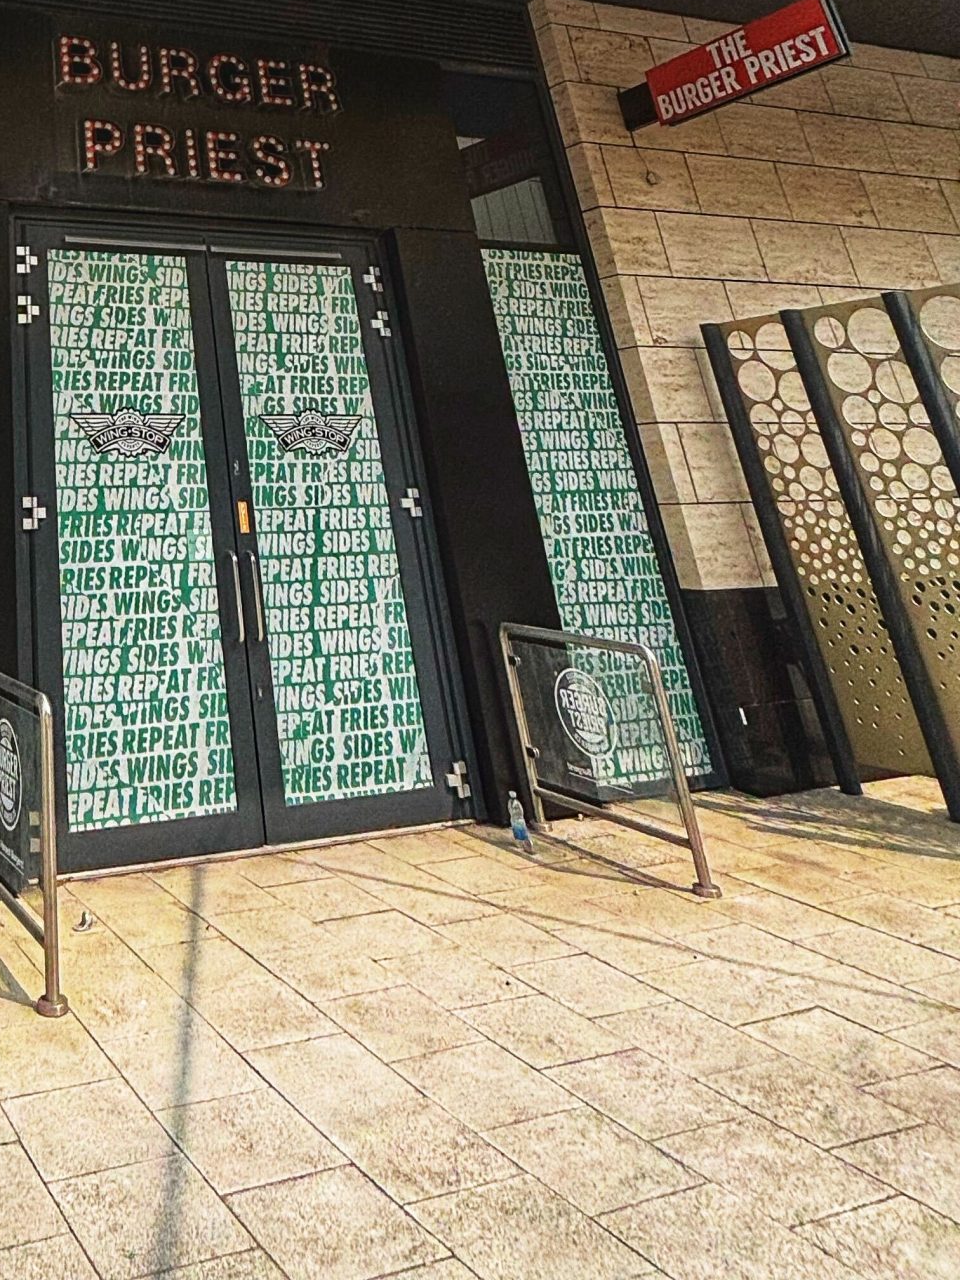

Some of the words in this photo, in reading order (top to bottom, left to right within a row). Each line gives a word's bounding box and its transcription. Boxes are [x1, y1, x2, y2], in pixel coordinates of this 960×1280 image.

[706, 29, 752, 69] THE
[58, 34, 342, 113] BURGER
[657, 66, 741, 121] BURGER
[744, 26, 830, 84] PRIEST
[84, 119, 332, 189] PRIEST
[89, 263, 149, 283] WINGS
[273, 274, 317, 293] SIDES
[266, 292, 329, 314] REPEAT
[99, 305, 147, 327] SIDES
[270, 312, 329, 334] WINGS
[514, 317, 562, 336] WINGS
[90, 327, 157, 350] REPEAT
[281, 334, 327, 355] FRIES
[93, 349, 155, 370] WINGS
[283, 354, 329, 374] SIDES
[94, 371, 164, 392] REPEAT
[291, 375, 334, 395] FRIES
[534, 411, 585, 430] REPEAT
[540, 429, 589, 450] WINGS
[301, 461, 346, 483] FRIES
[551, 450, 589, 470] FRIES
[100, 463, 171, 487] REPEAT
[555, 470, 595, 491] SIDES
[103, 487, 170, 510] WINGS
[304, 483, 350, 507] SIDES
[571, 492, 609, 511] FRIES
[59, 512, 113, 538] FRIES
[319, 506, 366, 530] FRIES
[574, 513, 614, 533] SIDES
[60, 539, 115, 564] SIDES
[121, 536, 188, 561] WINGS
[257, 531, 315, 556] WINGS
[322, 529, 370, 554] SIDES
[108, 562, 184, 589] REPEAT
[316, 555, 365, 581] FRIES
[114, 589, 182, 617] WINGS
[320, 578, 369, 607] SIDES
[582, 580, 638, 603] REPEAT
[313, 602, 379, 631] REPEAT
[584, 601, 638, 626] WINGS
[319, 627, 381, 655] WINGS
[126, 641, 180, 673] SIDES
[330, 652, 379, 681] FRIES
[117, 668, 192, 701] REPEAT
[332, 679, 382, 707] SIDES
[118, 695, 190, 727] WINGS
[339, 704, 388, 733] FRIES
[122, 722, 200, 755] REPEAT
[343, 730, 393, 760] SIDES
[126, 750, 199, 785] WINGS
[336, 756, 406, 790] REPEAT
[136, 780, 194, 815] FRIES
